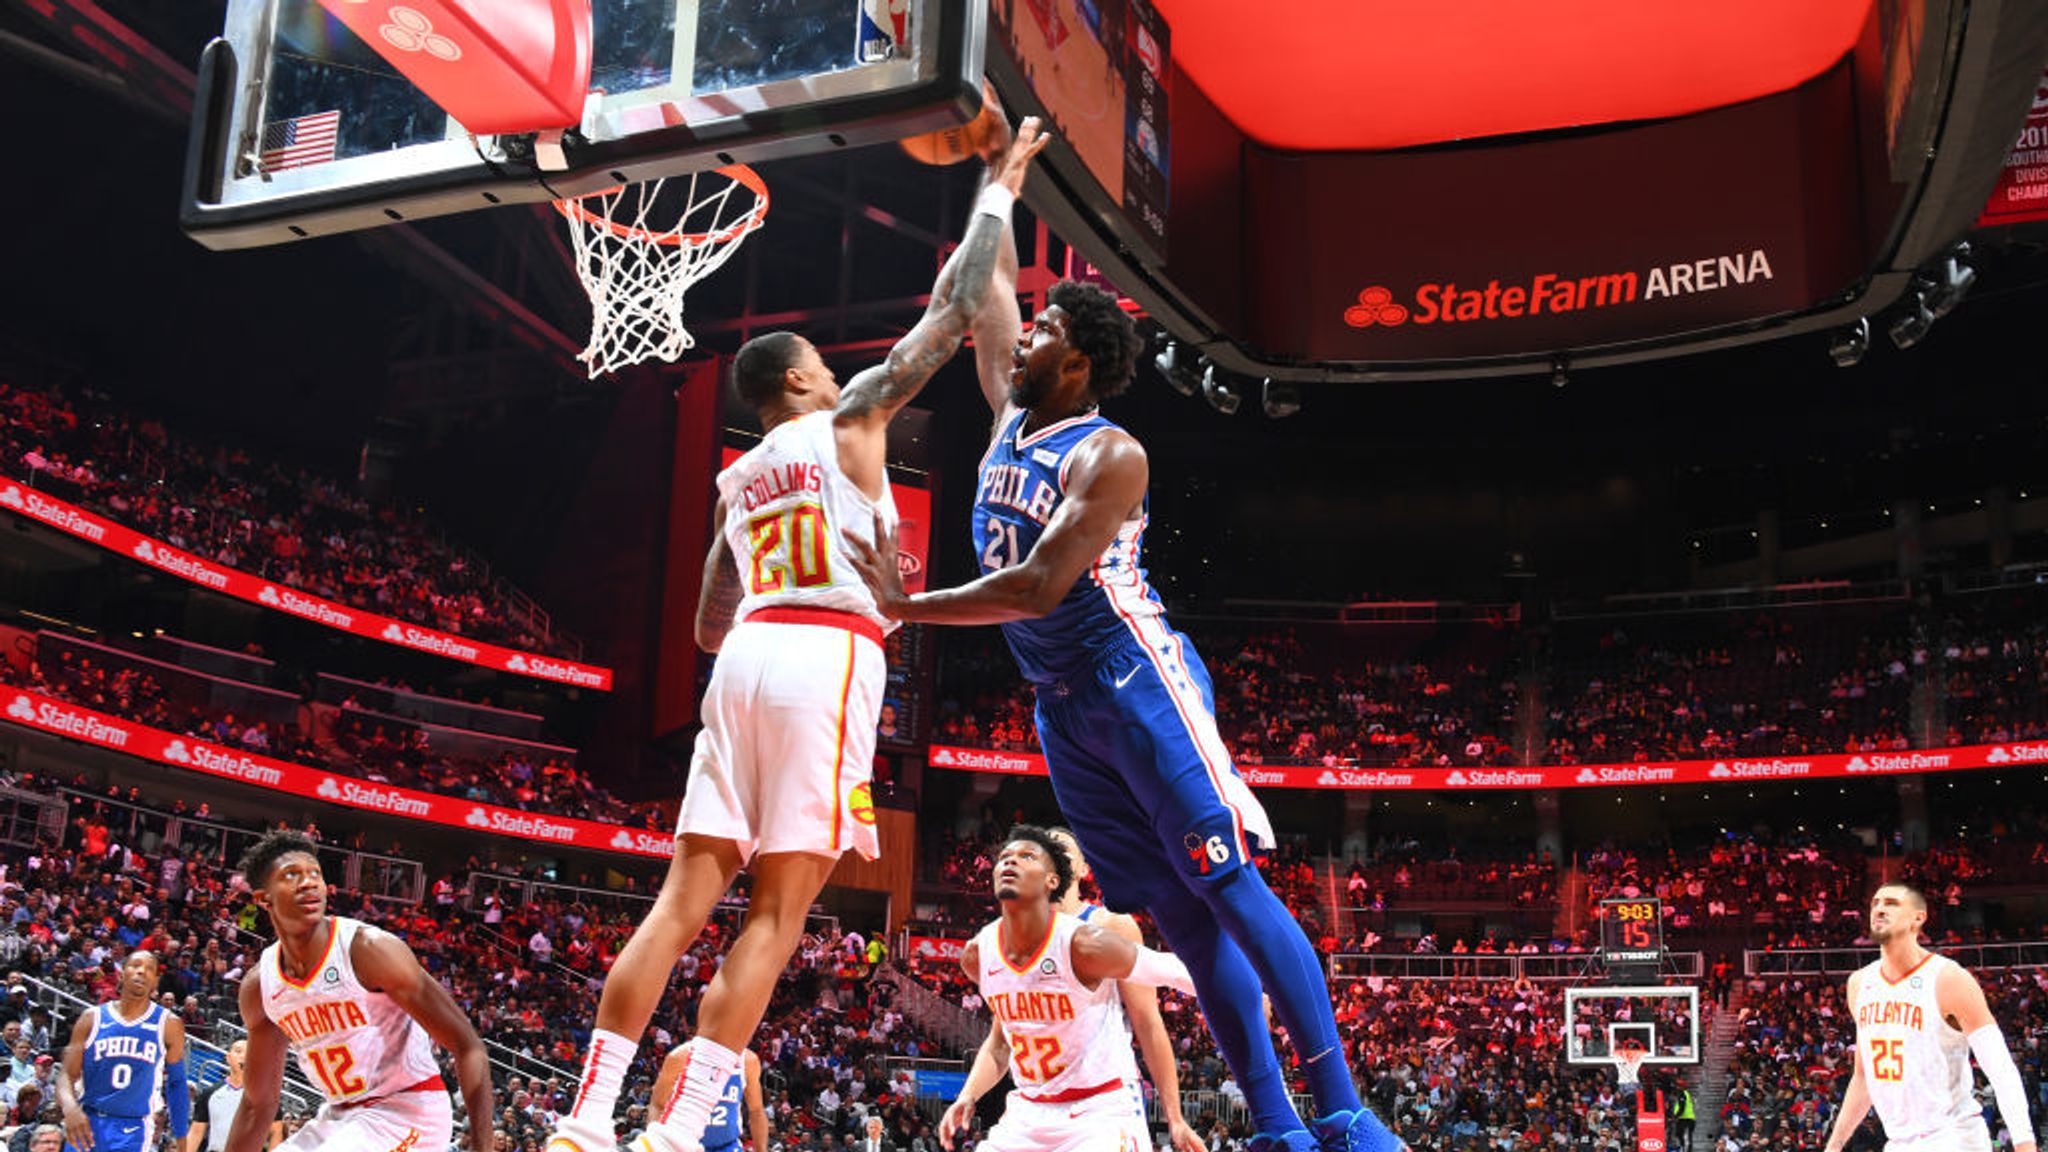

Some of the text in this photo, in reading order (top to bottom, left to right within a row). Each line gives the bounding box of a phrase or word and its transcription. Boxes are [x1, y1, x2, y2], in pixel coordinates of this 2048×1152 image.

[1644, 249, 1773, 299] ARENA
[743, 462, 822, 511] COLLINS
[750, 502, 833, 594] 20
[983, 517, 1019, 569] 21
[1617, 903, 1654, 920] 9:03
[1623, 919, 1651, 948] 15
[278, 1000, 367, 1041] ATLANTA
[987, 992, 1075, 1021] ATLANTA
[1859, 1001, 1923, 1031] ATLANTA
[94, 1036, 157, 1064] PHILA
[307, 1043, 367, 1097] 12
[1011, 1032, 1068, 1083] 22
[1870, 1038, 1904, 1081] 25
[112, 1063, 132, 1090] 0
